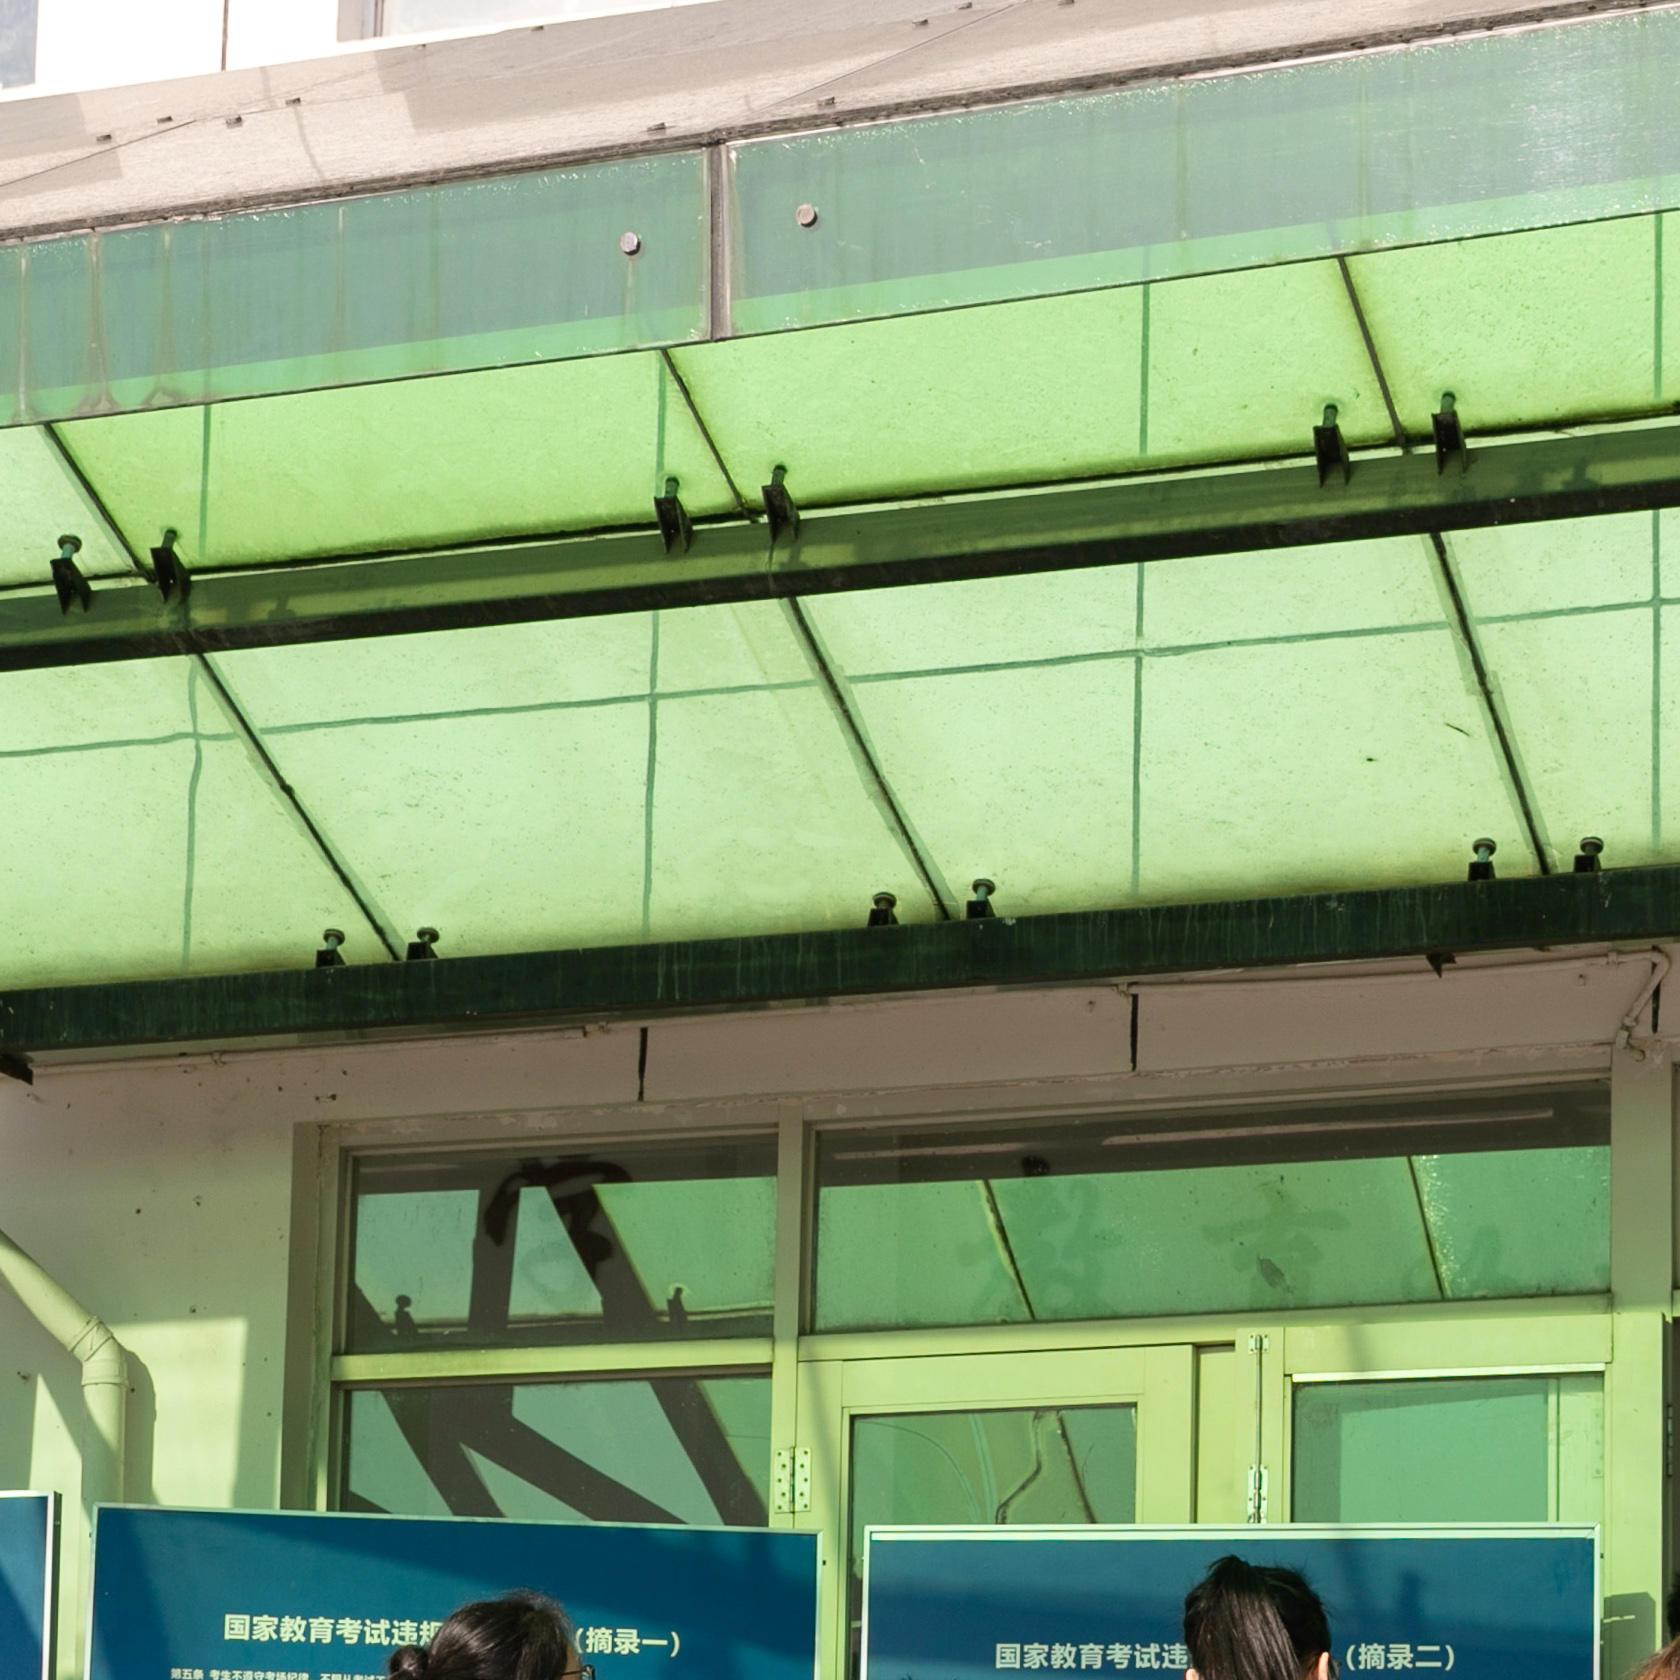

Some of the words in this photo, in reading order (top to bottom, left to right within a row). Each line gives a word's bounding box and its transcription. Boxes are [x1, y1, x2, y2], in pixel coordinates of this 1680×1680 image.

[575, 1627, 681, 1658] （摘录一）
[1346, 1643, 1455, 1671] （摘录二）
